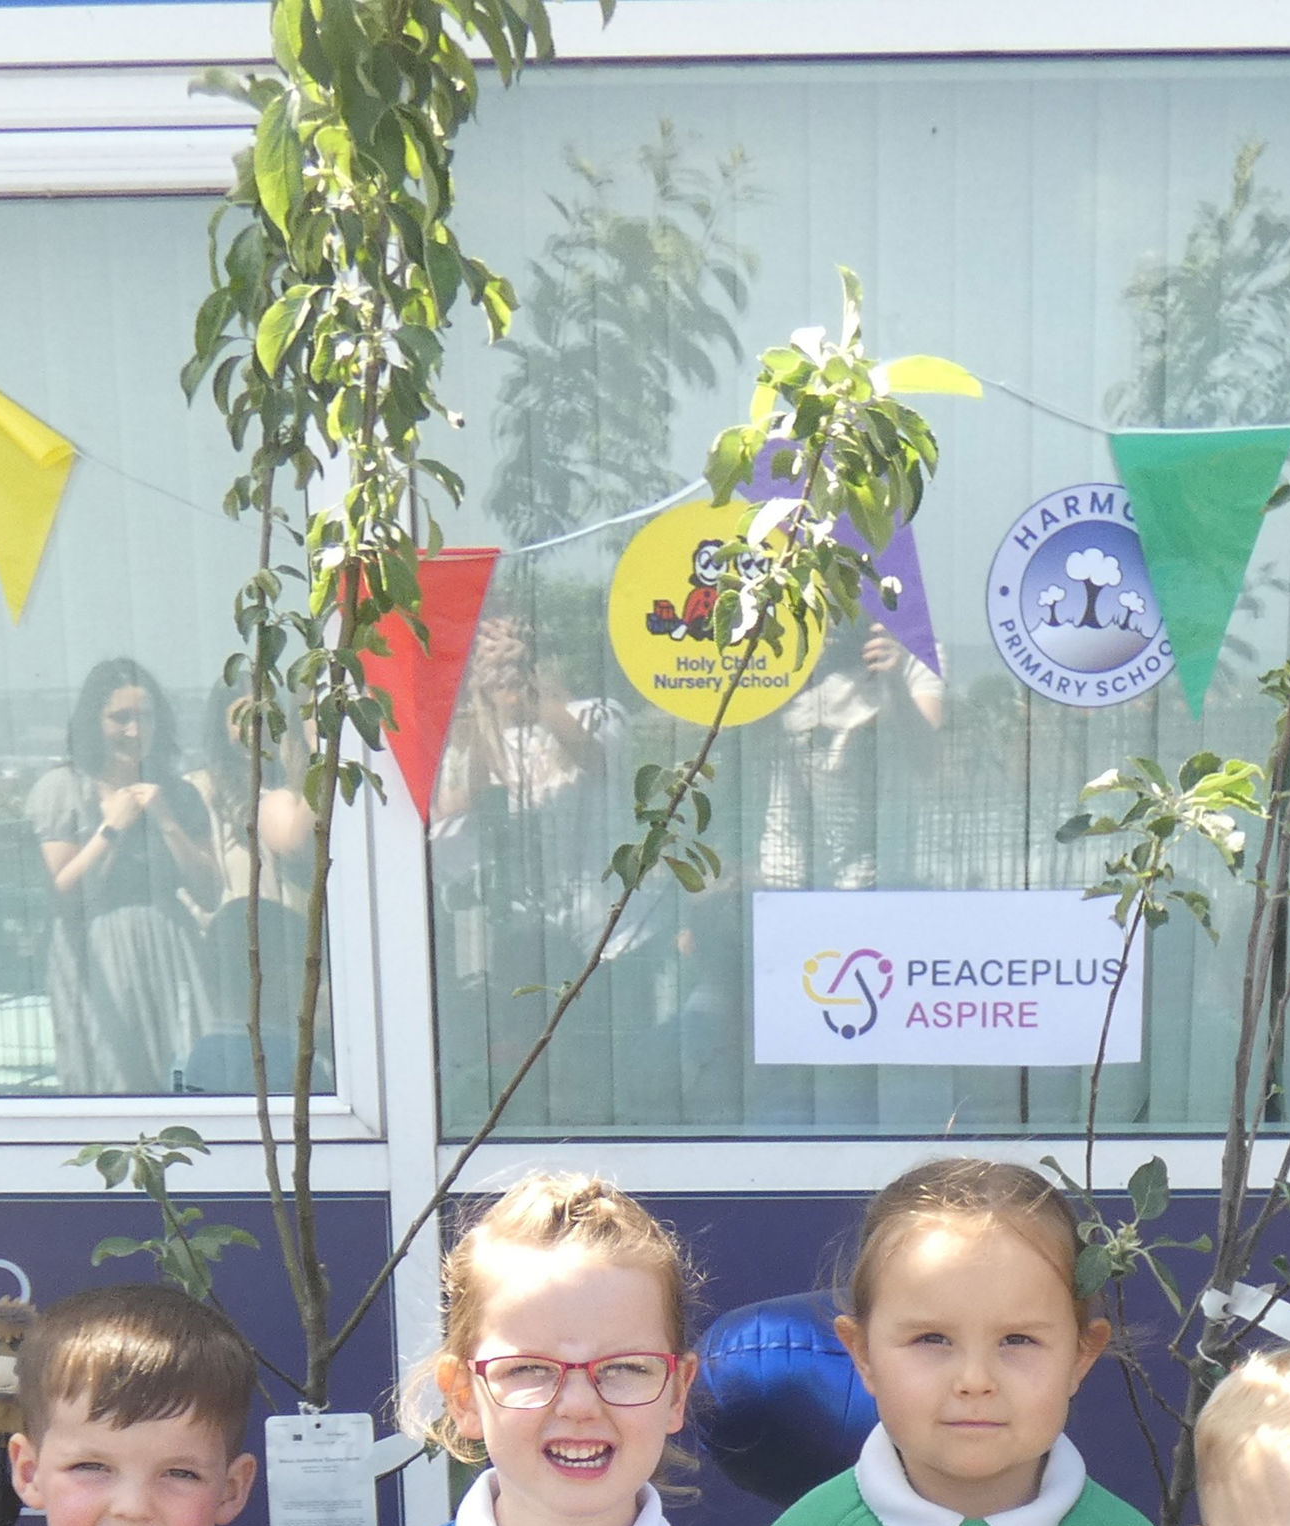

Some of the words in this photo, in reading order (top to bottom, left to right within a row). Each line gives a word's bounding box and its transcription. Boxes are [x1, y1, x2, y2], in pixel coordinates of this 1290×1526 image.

[676, 656, 716, 674] Holy
[999, 619, 1088, 697] PRIMARY
[1096, 640, 1173, 697] SCHOO
[654, 674, 723, 692] Nursery
[907, 958, 1123, 986] PEACEPLUS
[905, 1001, 1039, 1028] ASPIRE
